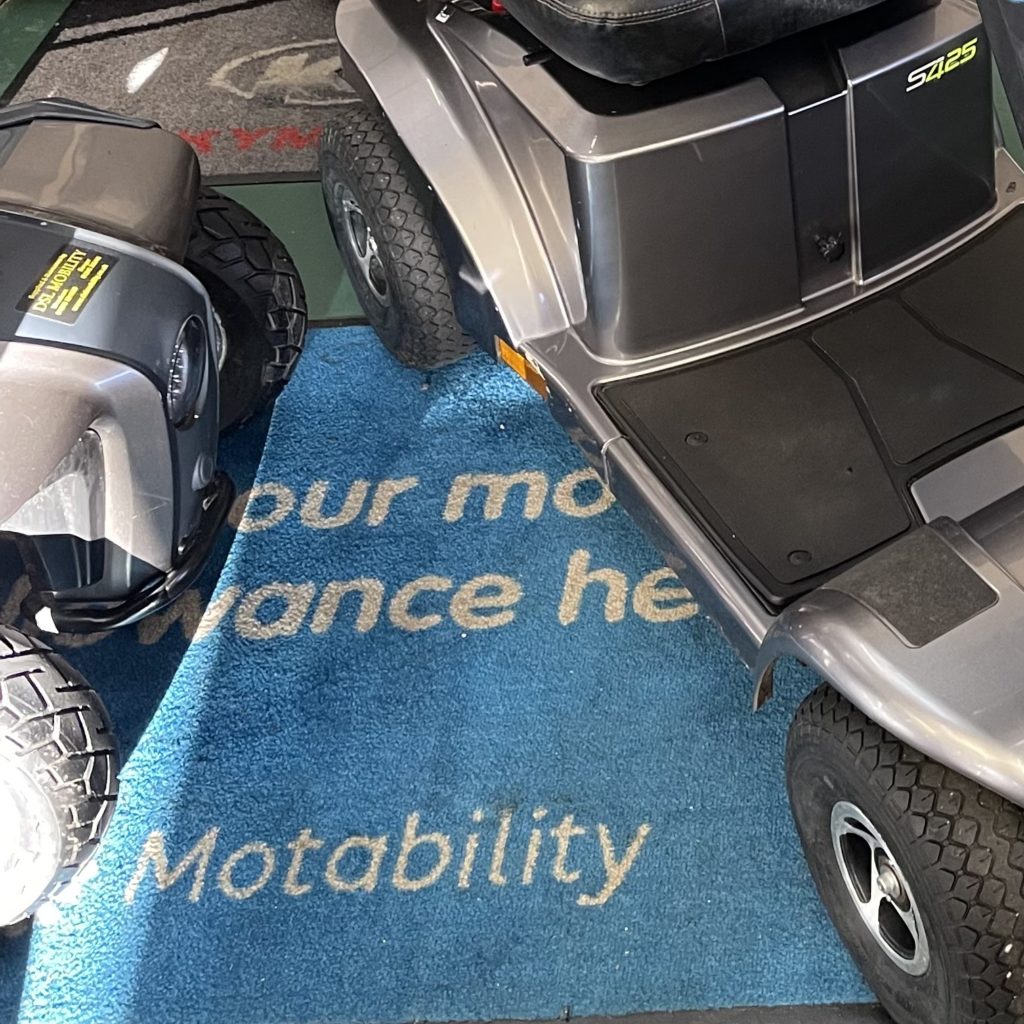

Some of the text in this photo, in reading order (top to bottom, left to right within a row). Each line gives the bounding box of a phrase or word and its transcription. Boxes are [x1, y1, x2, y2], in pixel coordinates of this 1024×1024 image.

[906, 37, 978, 92] S425
[31, 291, 57, 313] DSL
[46, 249, 87, 292] MOBILITY
[121, 808, 653, 908] Motability
